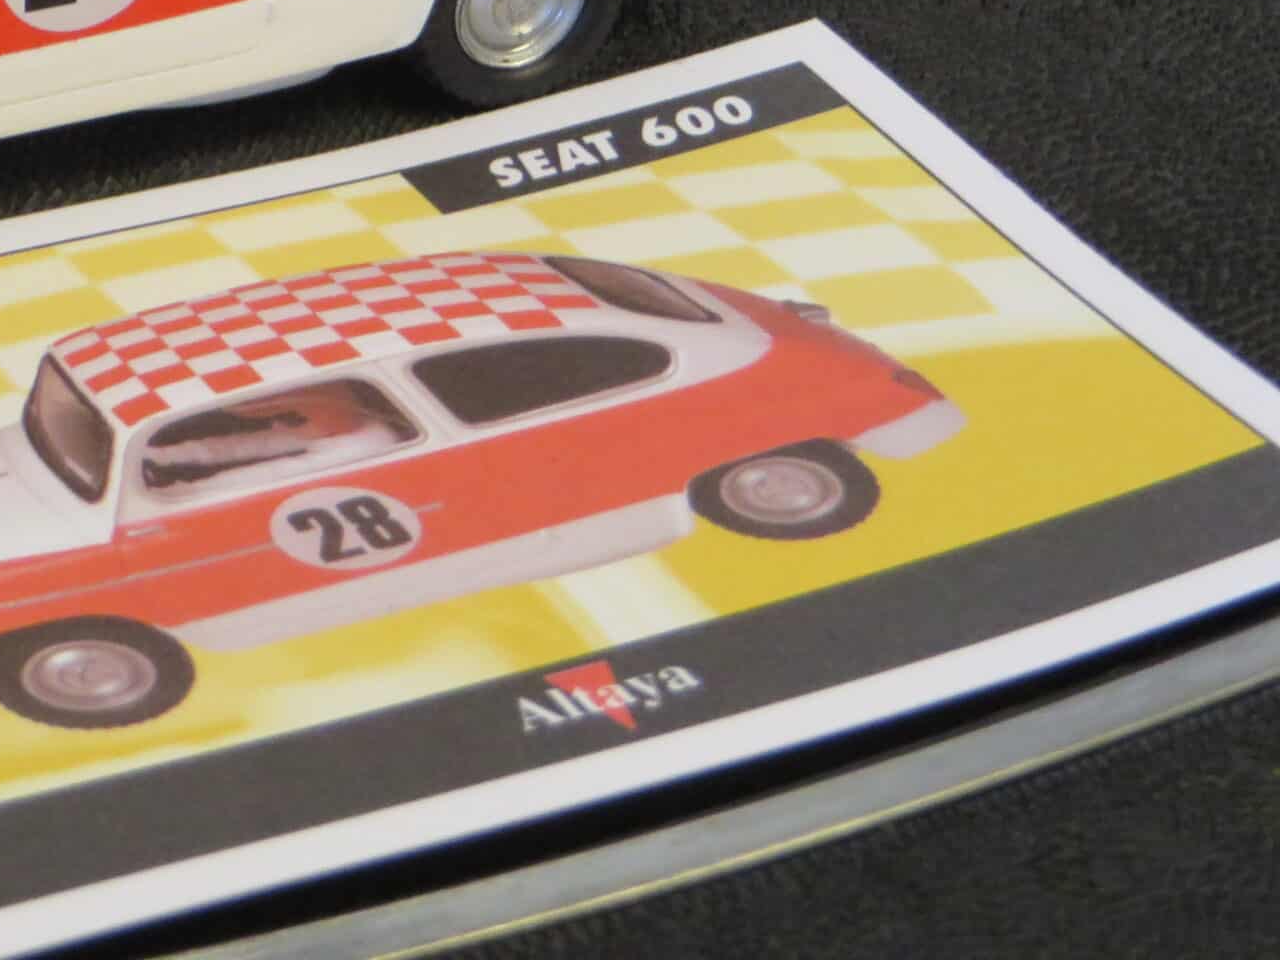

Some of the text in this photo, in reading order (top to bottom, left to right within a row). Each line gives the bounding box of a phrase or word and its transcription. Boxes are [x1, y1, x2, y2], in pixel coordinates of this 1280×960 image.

[488, 95, 753, 189] SEAT 600
[286, 495, 413, 563] 28
[517, 664, 701, 733] Altaya
